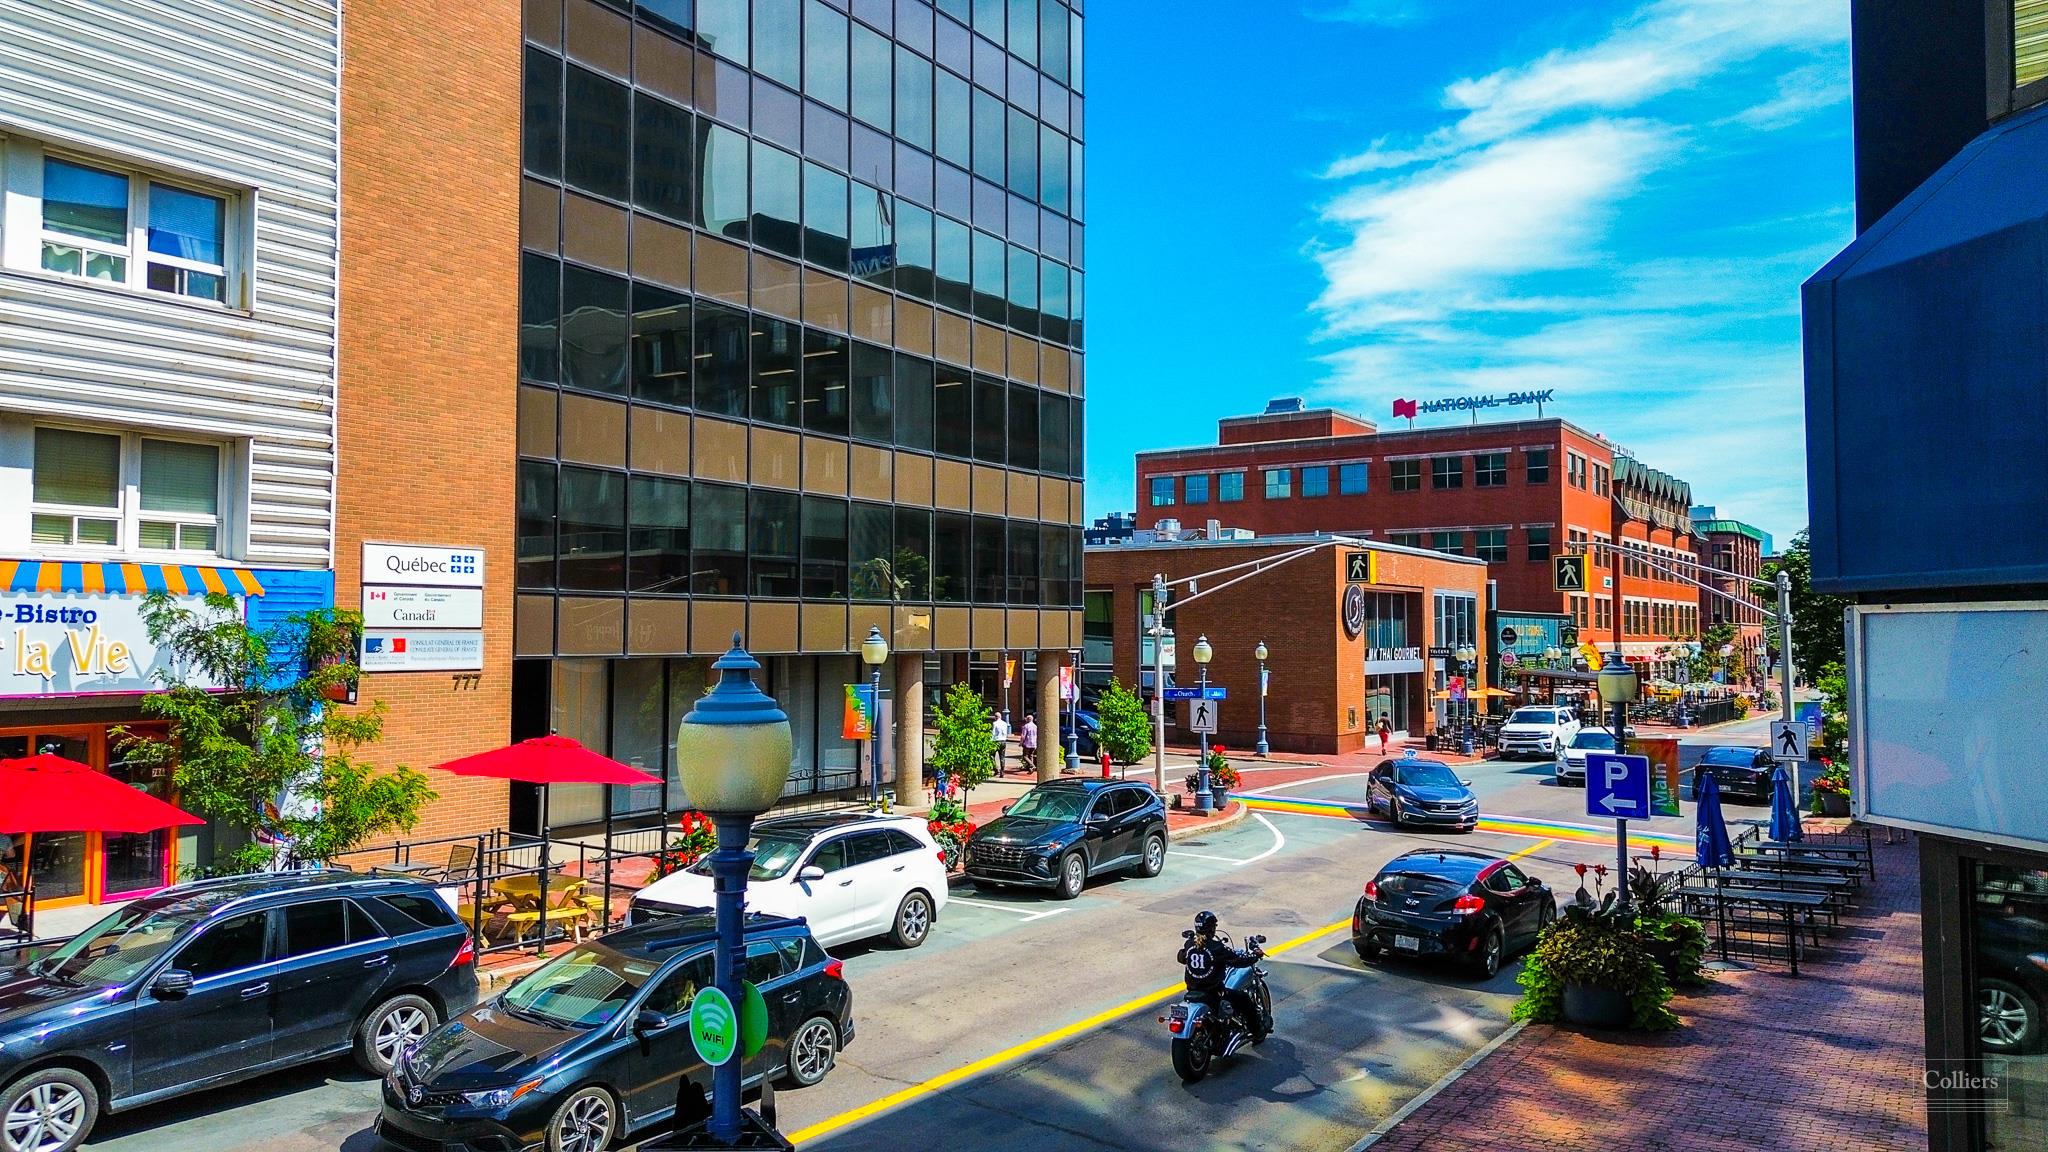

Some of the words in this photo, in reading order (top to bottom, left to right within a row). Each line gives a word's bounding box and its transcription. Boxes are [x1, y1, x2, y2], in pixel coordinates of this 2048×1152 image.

[1422, 394, 1499, 413] NATIONAL
[1508, 388, 1554, 406] BANK
[386, 555, 447, 574] Québec
[393, 608, 436, 621] Canada
[13, 627, 56, 680] la
[65, 622, 130, 676] Vie
[1379, 648, 1393, 661] THAI
[1394, 647, 1421, 660] GOURMET
[452, 673, 482, 690] 777
[857, 702, 866, 733] Main
[1604, 760, 1629, 789] P
[1651, 763, 1668, 807] Main
[1190, 952, 1206, 970] 81
[701, 1030, 725, 1046] WiFi
